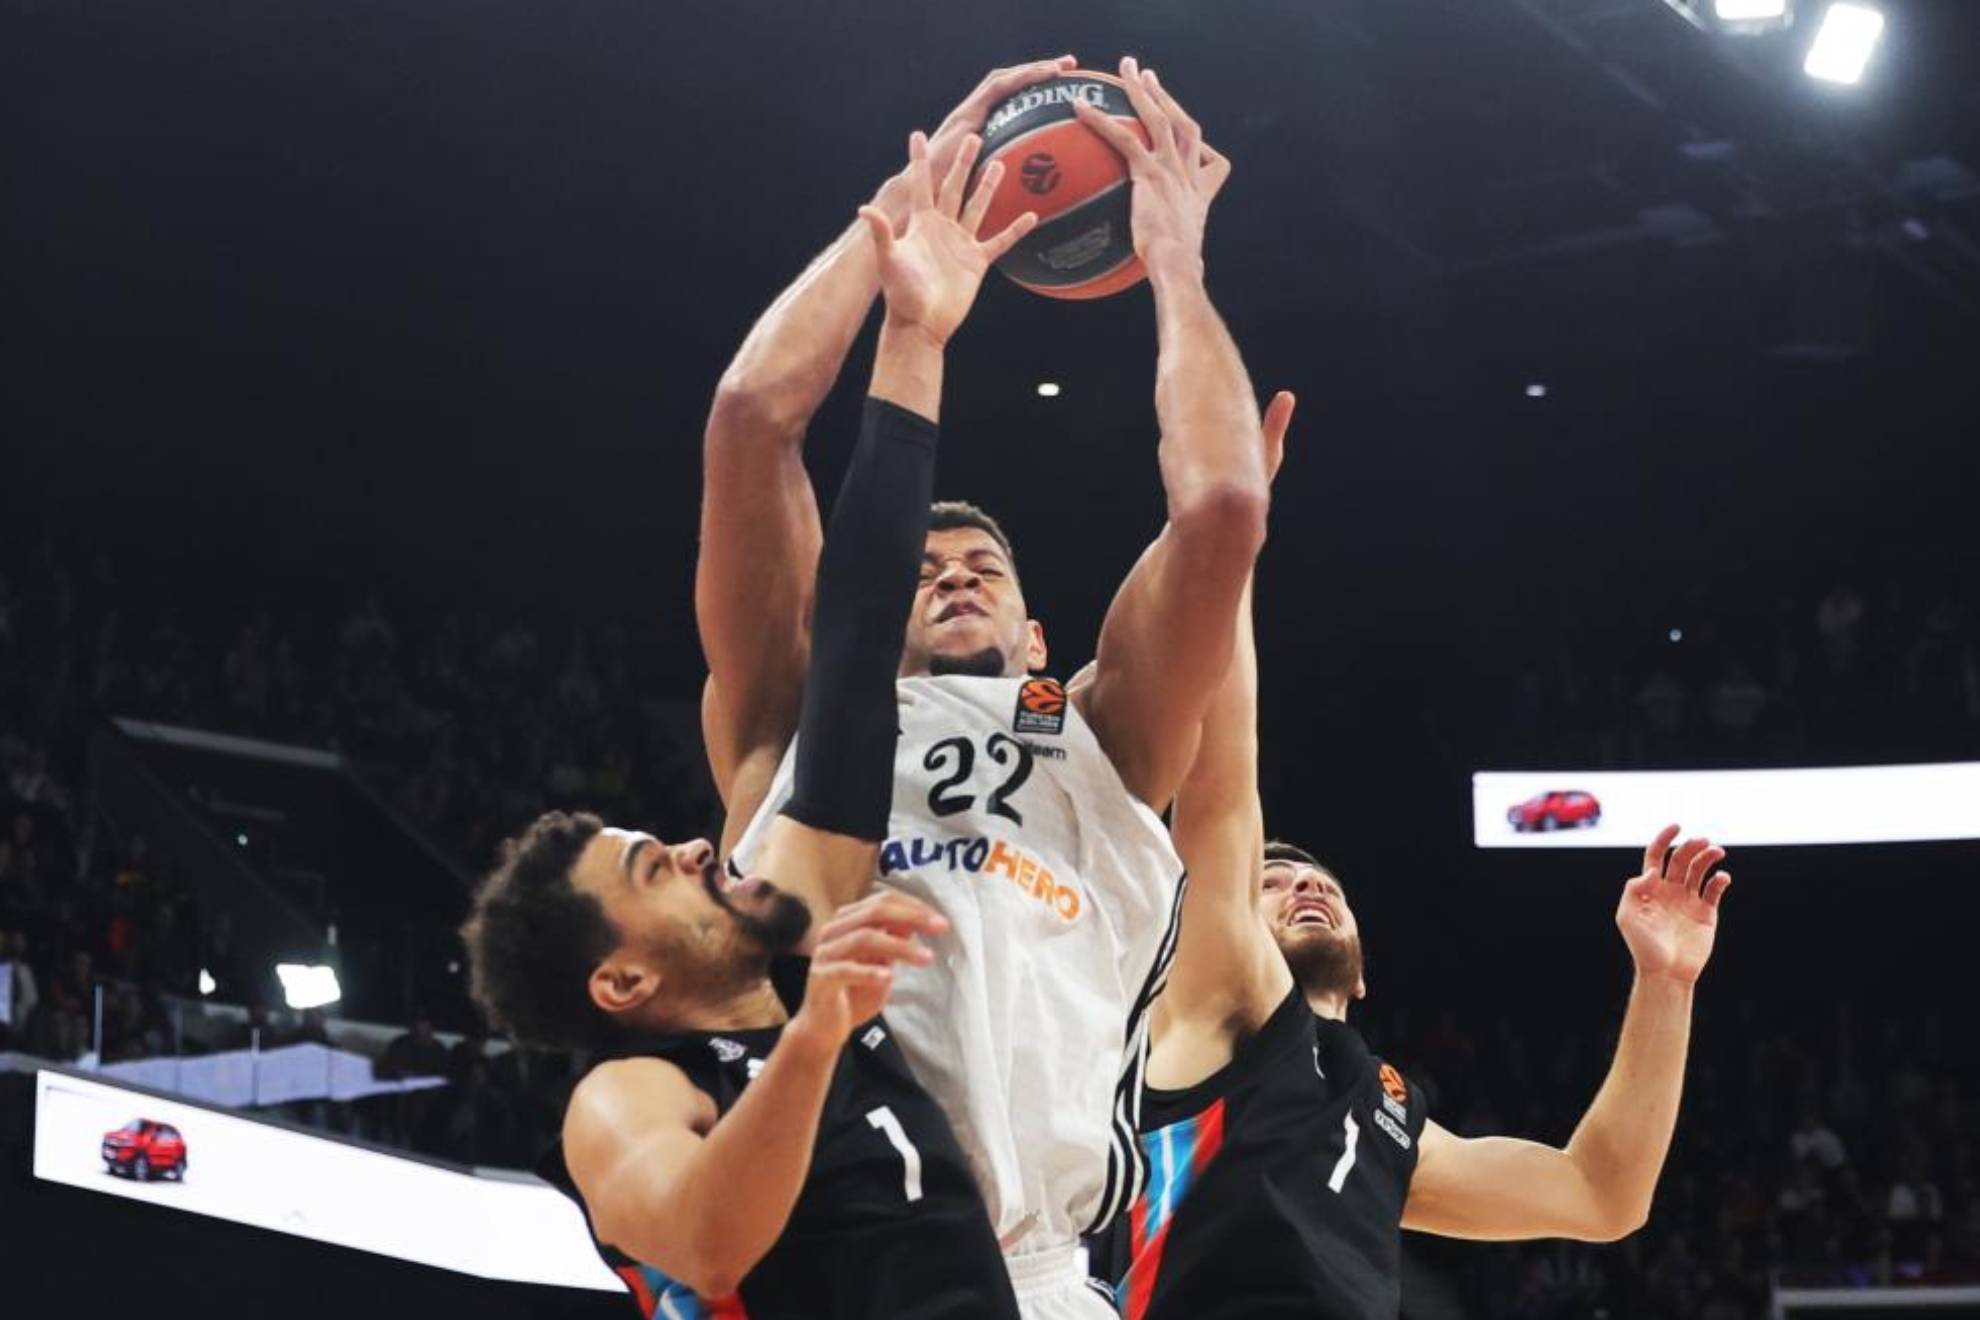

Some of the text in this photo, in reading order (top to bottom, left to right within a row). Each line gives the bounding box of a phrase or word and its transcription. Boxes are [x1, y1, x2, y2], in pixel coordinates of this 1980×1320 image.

[985, 84, 1106, 136] ALDING
[923, 731, 1033, 828] 22
[880, 836, 1080, 920] AUTOHERO
[865, 1105, 922, 1202] 1
[1327, 1106, 1361, 1194] 1
